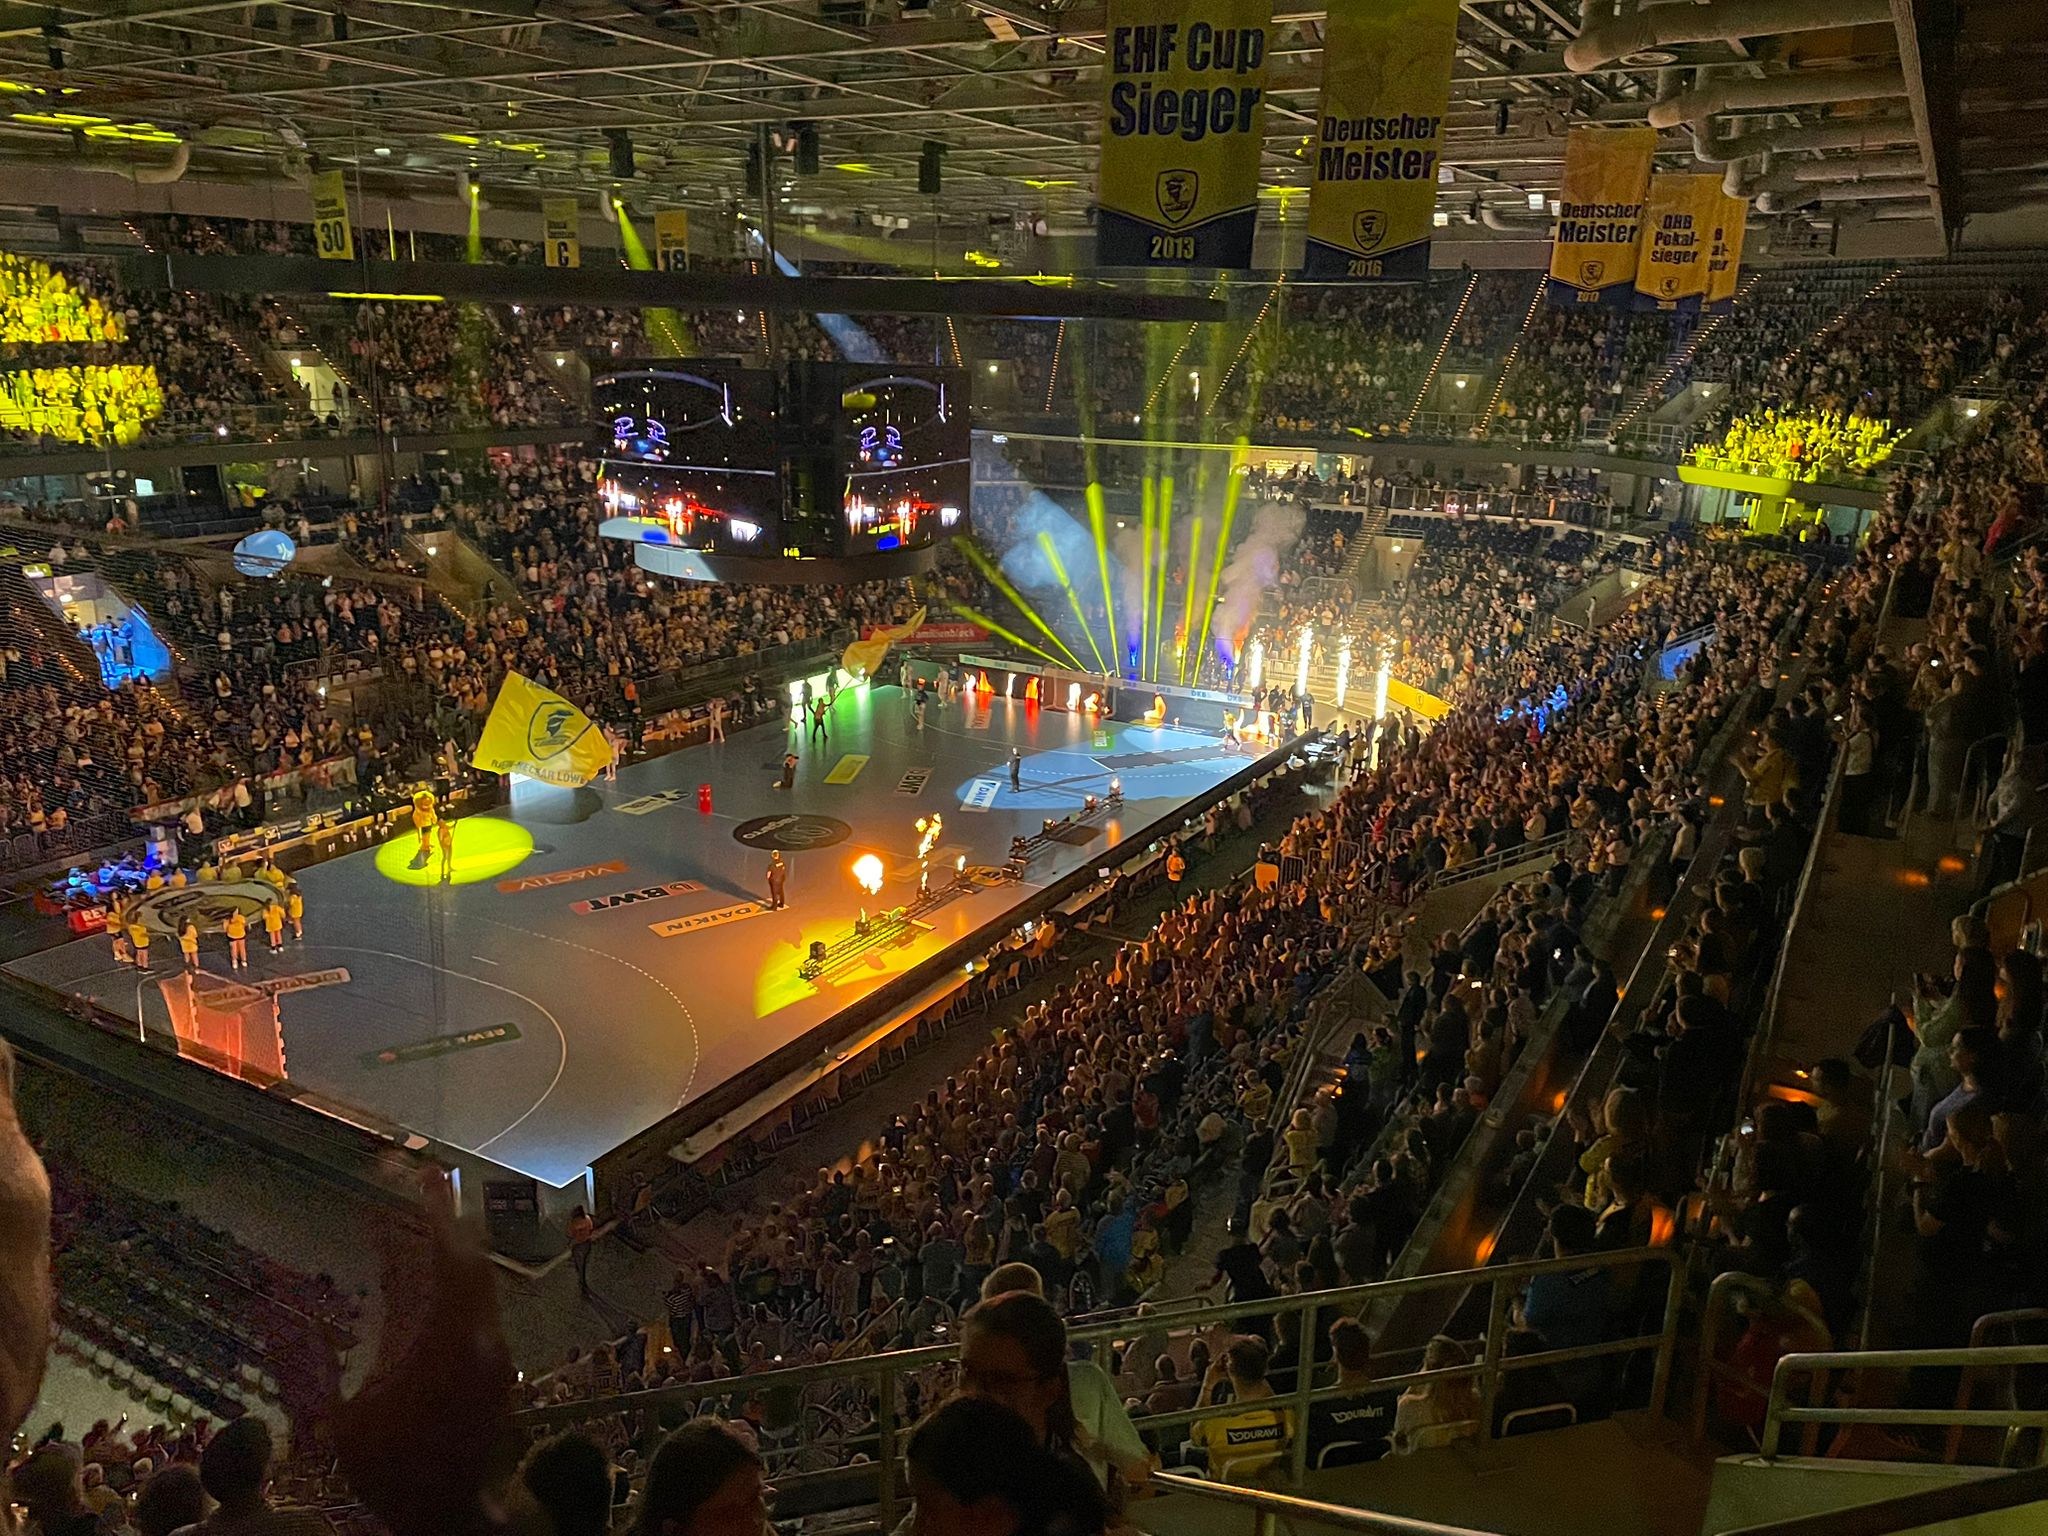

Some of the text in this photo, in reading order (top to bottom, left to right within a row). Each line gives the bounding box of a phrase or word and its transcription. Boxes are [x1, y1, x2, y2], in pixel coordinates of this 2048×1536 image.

[1113, 21, 1265, 75] EHF Cup
[1109, 80, 1262, 142] Sieger
[1321, 112, 1441, 142] Deutscher
[1317, 145, 1437, 182] Meister
[1560, 202, 1643, 219] Deutscher
[1662, 214, 1692, 230] DHB
[320, 220, 345, 253] 30
[1557, 220, 1639, 244] Meister
[1654, 231, 1700, 247] Pokal-
[1150, 235, 1195, 260] 2013
[1650, 246, 1699, 265] sieger
[662, 249, 688, 274] 18
[1347, 259, 1383, 277] 2016
[590, 886, 670, 911] BWT
[666, 906, 752, 933] DAIKIN
